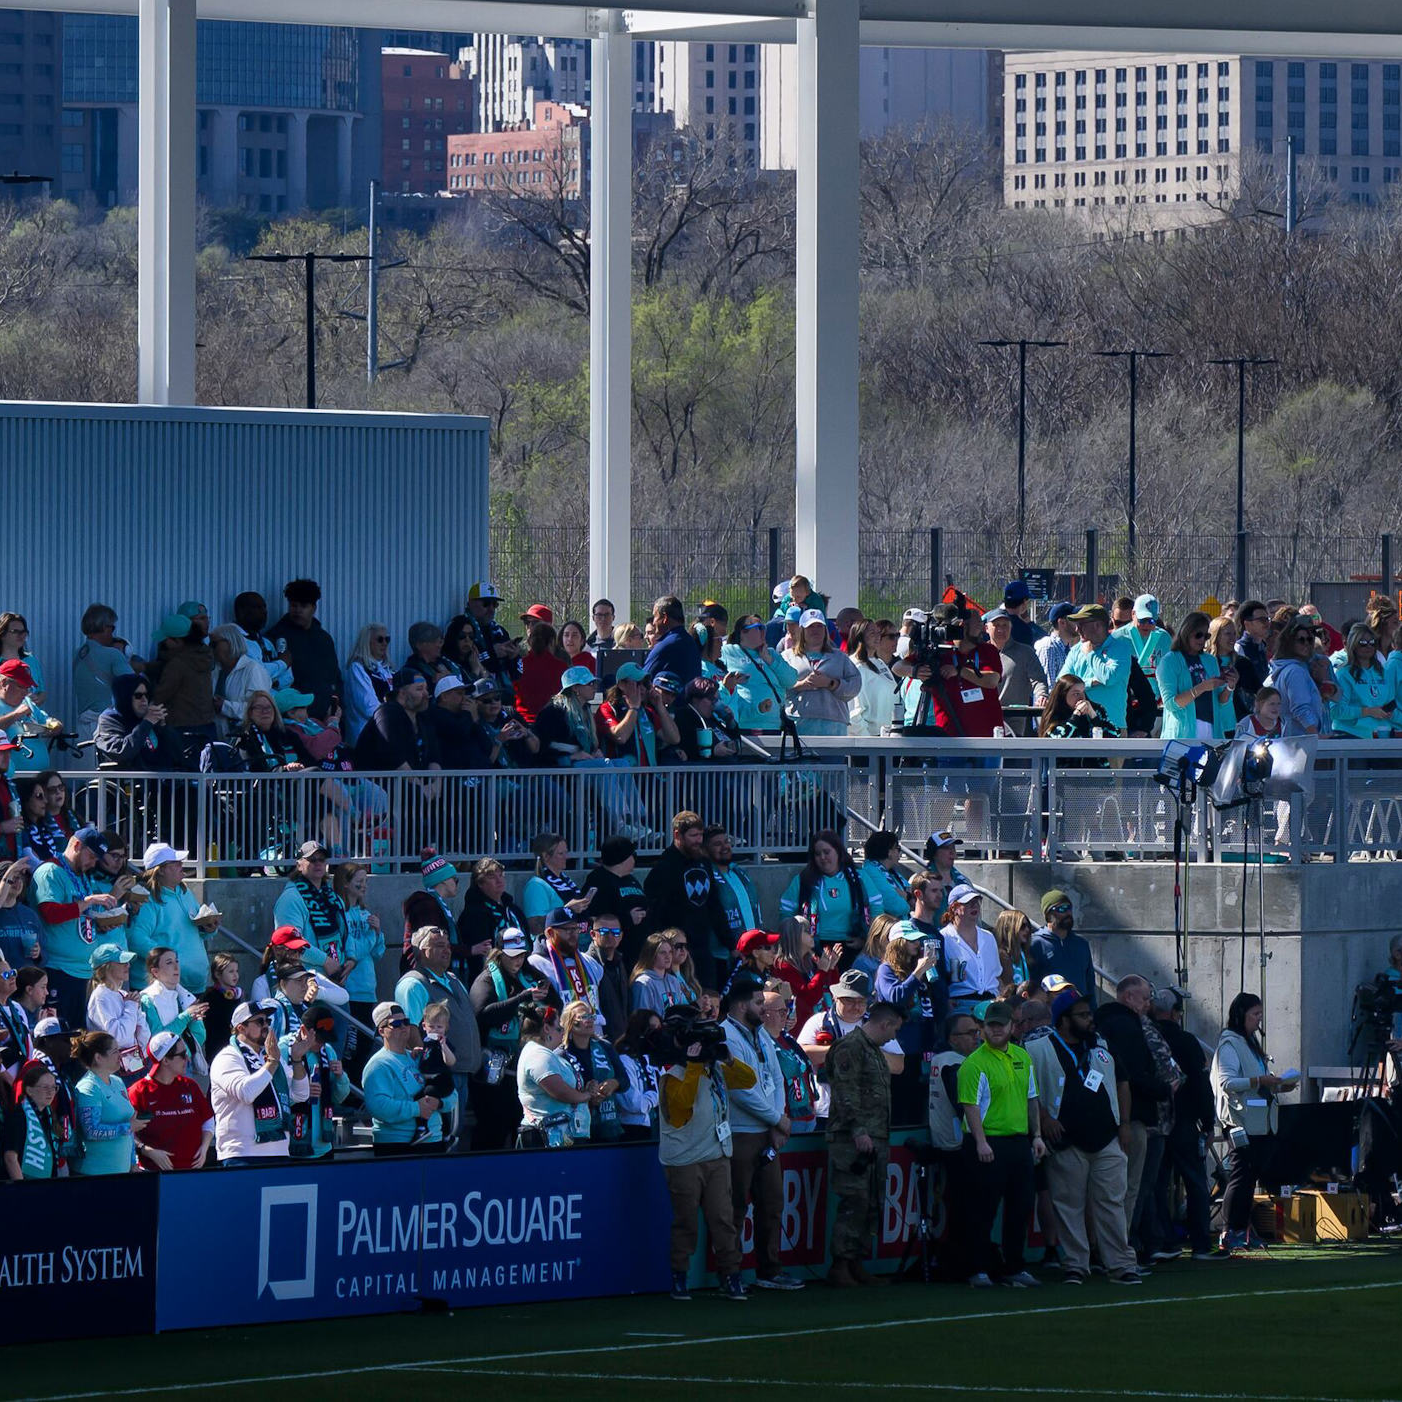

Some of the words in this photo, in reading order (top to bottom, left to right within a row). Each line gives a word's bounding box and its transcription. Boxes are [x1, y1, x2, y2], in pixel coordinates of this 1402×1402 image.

[336, 1199, 456, 1257] PALMER
[463, 1190, 582, 1244] SQUARE
[62, 1244, 144, 1282] SYSTEM
[335, 1271, 419, 1299] CAPITAL
[432, 1261, 575, 1291] MANAGEMENT
